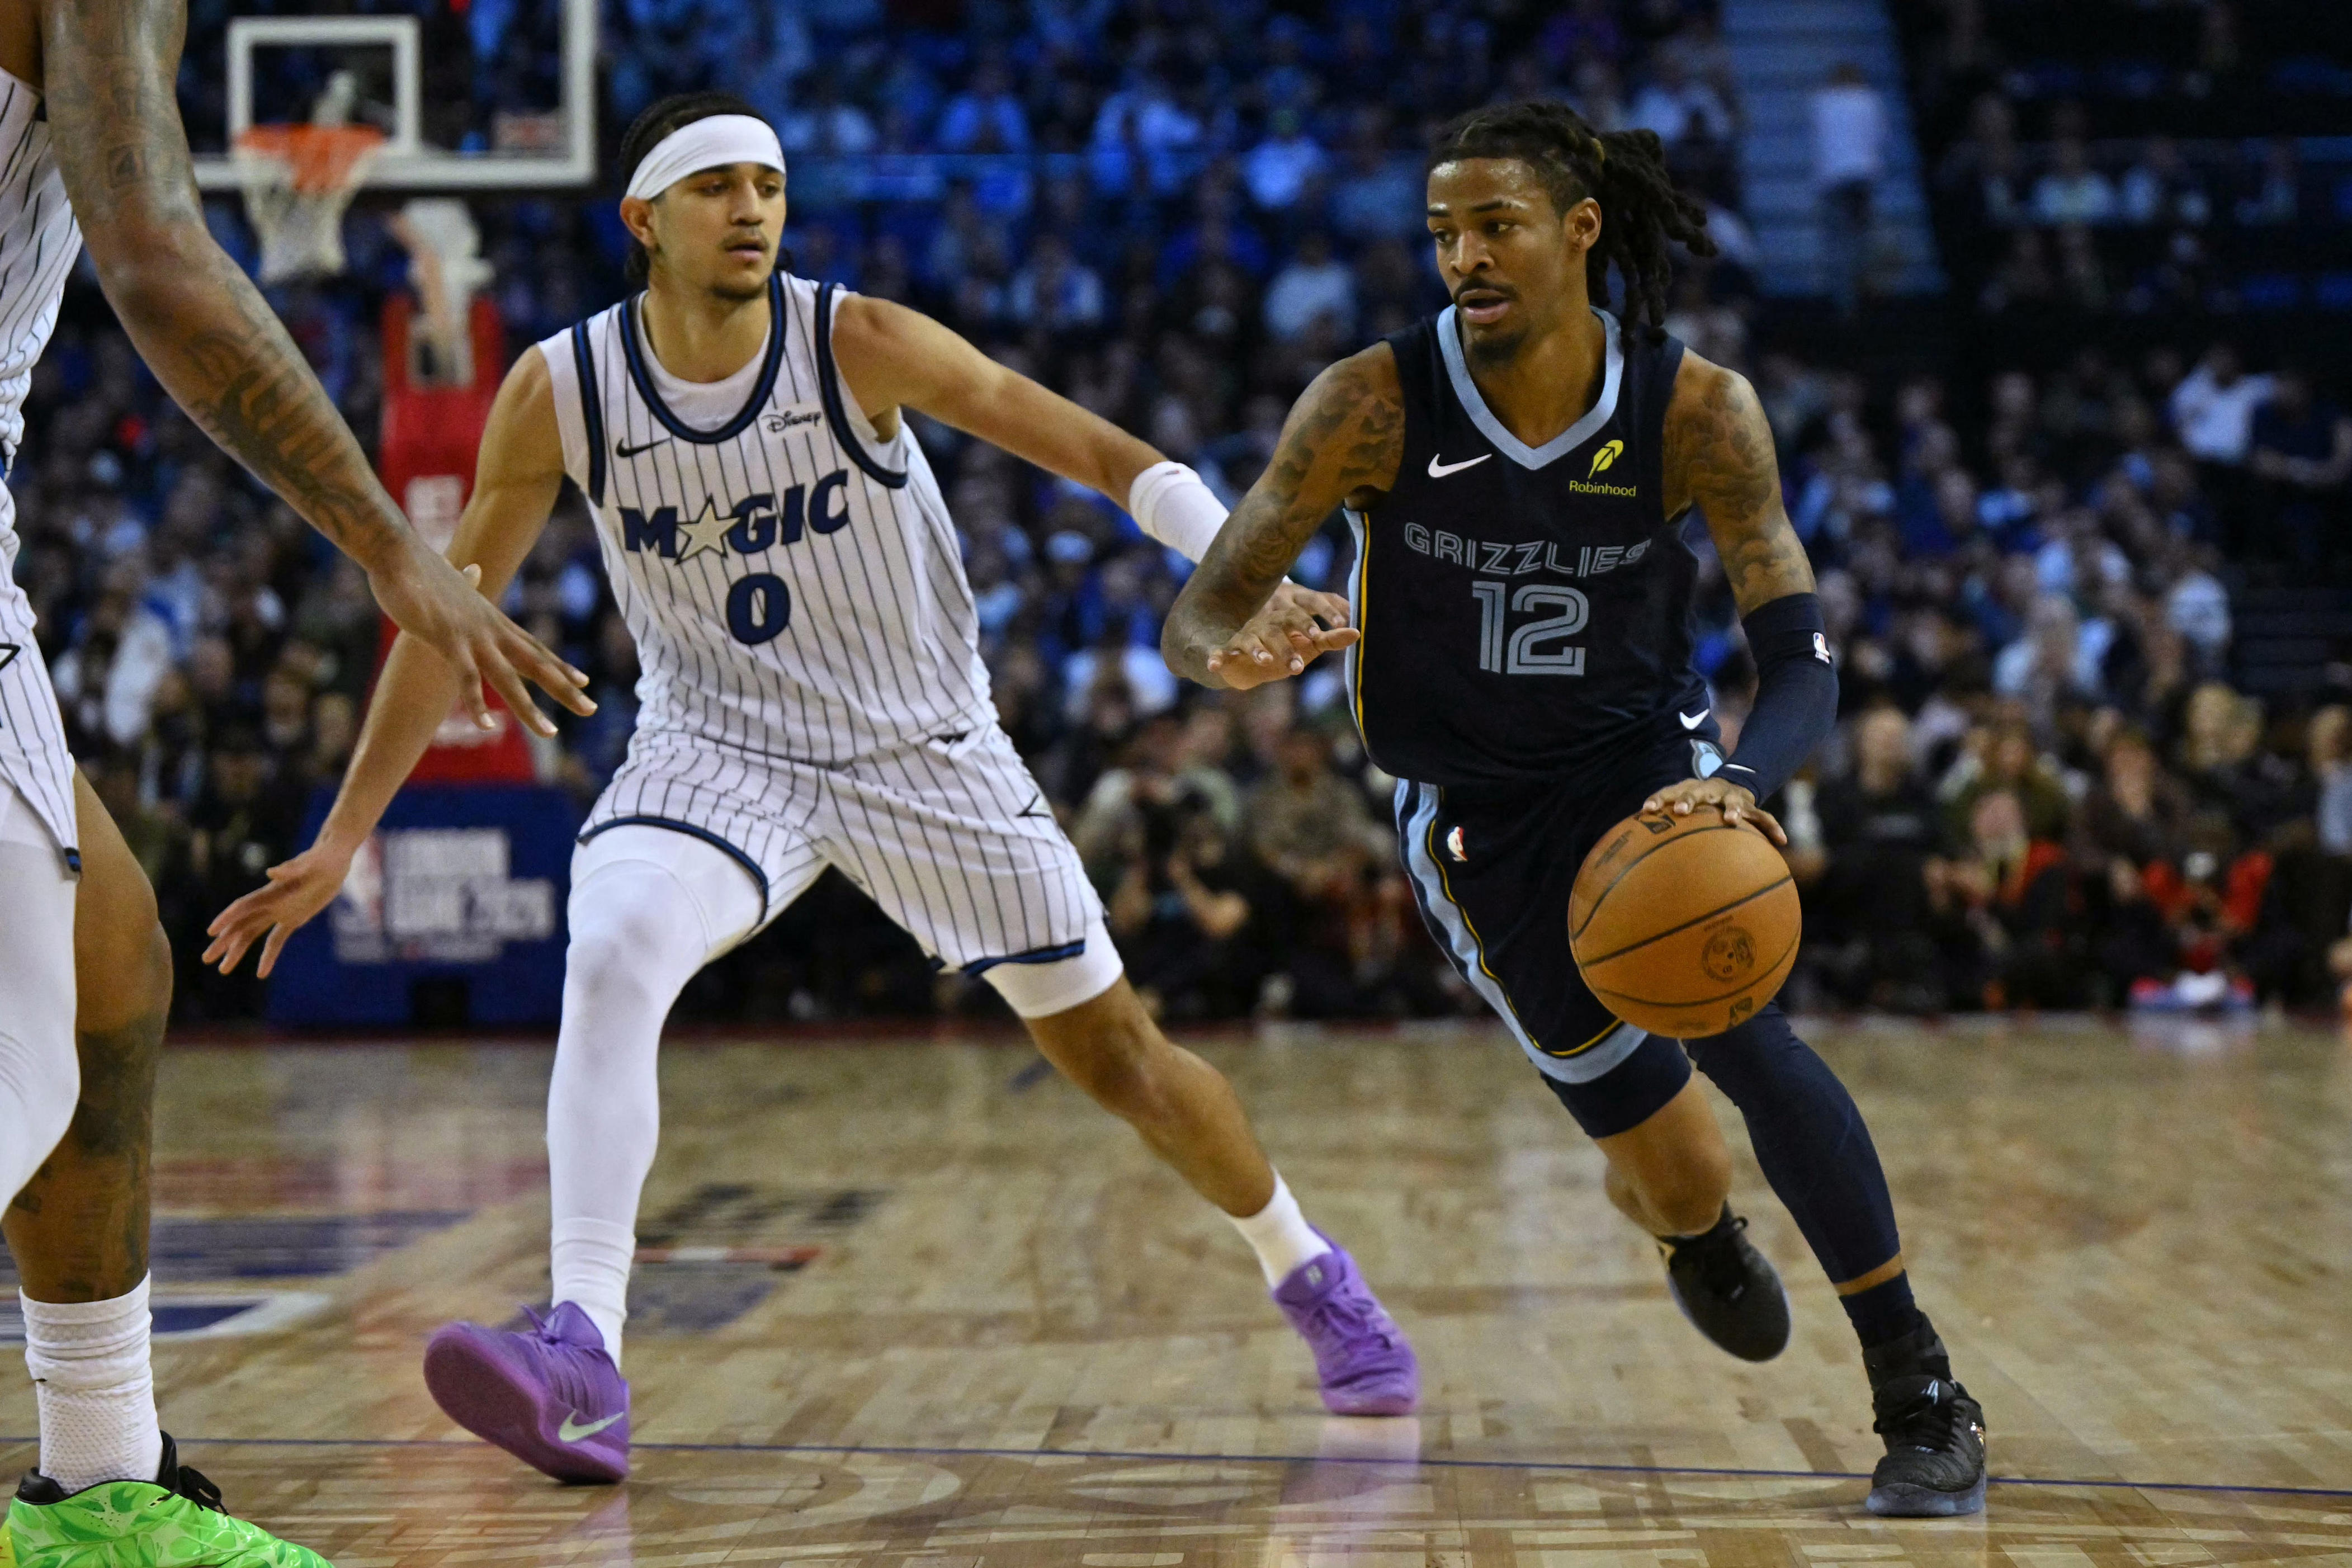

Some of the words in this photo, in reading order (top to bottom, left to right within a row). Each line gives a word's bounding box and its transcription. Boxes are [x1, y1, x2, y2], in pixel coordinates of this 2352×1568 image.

[761, 410, 821, 433] Disney
[1569, 480, 1636, 498] Robinhood
[1404, 522, 1652, 578] GRIZZLIES
[726, 573, 791, 645] 0
[1472, 580, 1589, 676] 12
